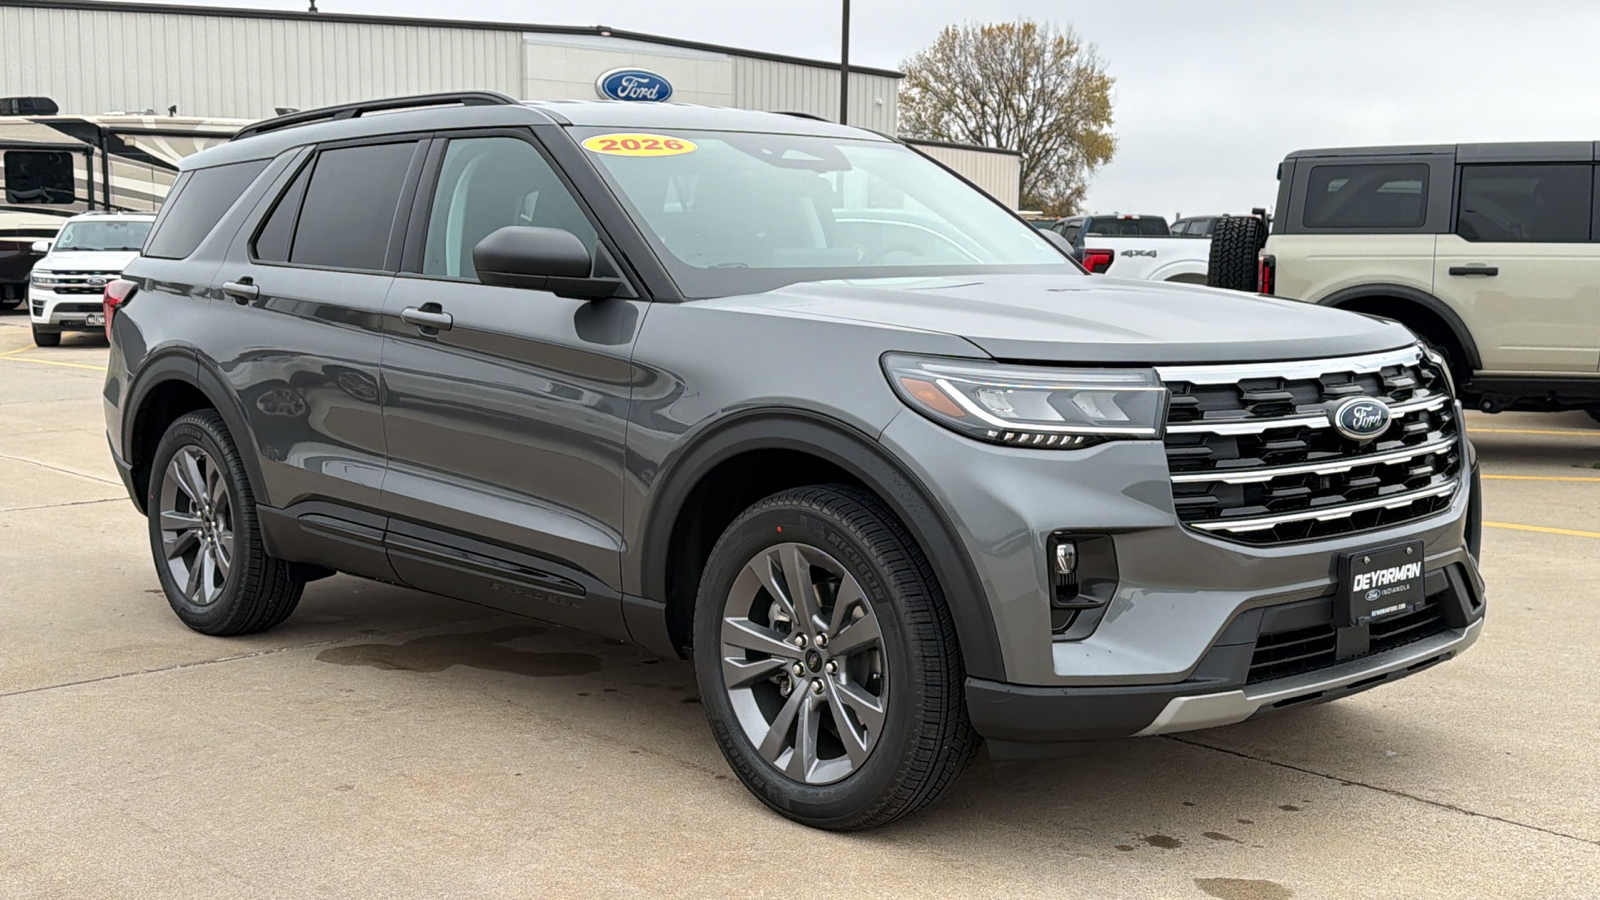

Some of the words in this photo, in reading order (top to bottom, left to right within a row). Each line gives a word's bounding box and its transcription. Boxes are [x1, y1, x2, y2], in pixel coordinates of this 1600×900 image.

[617, 75, 660, 99] Ford
[598, 139, 685, 151] 2026
[1353, 406, 1382, 429] Ford
[827, 531, 886, 600] MICHELIN
[1353, 561, 1421, 592] DEYARMAN
[1381, 584, 1410, 596] INDIANOLA
